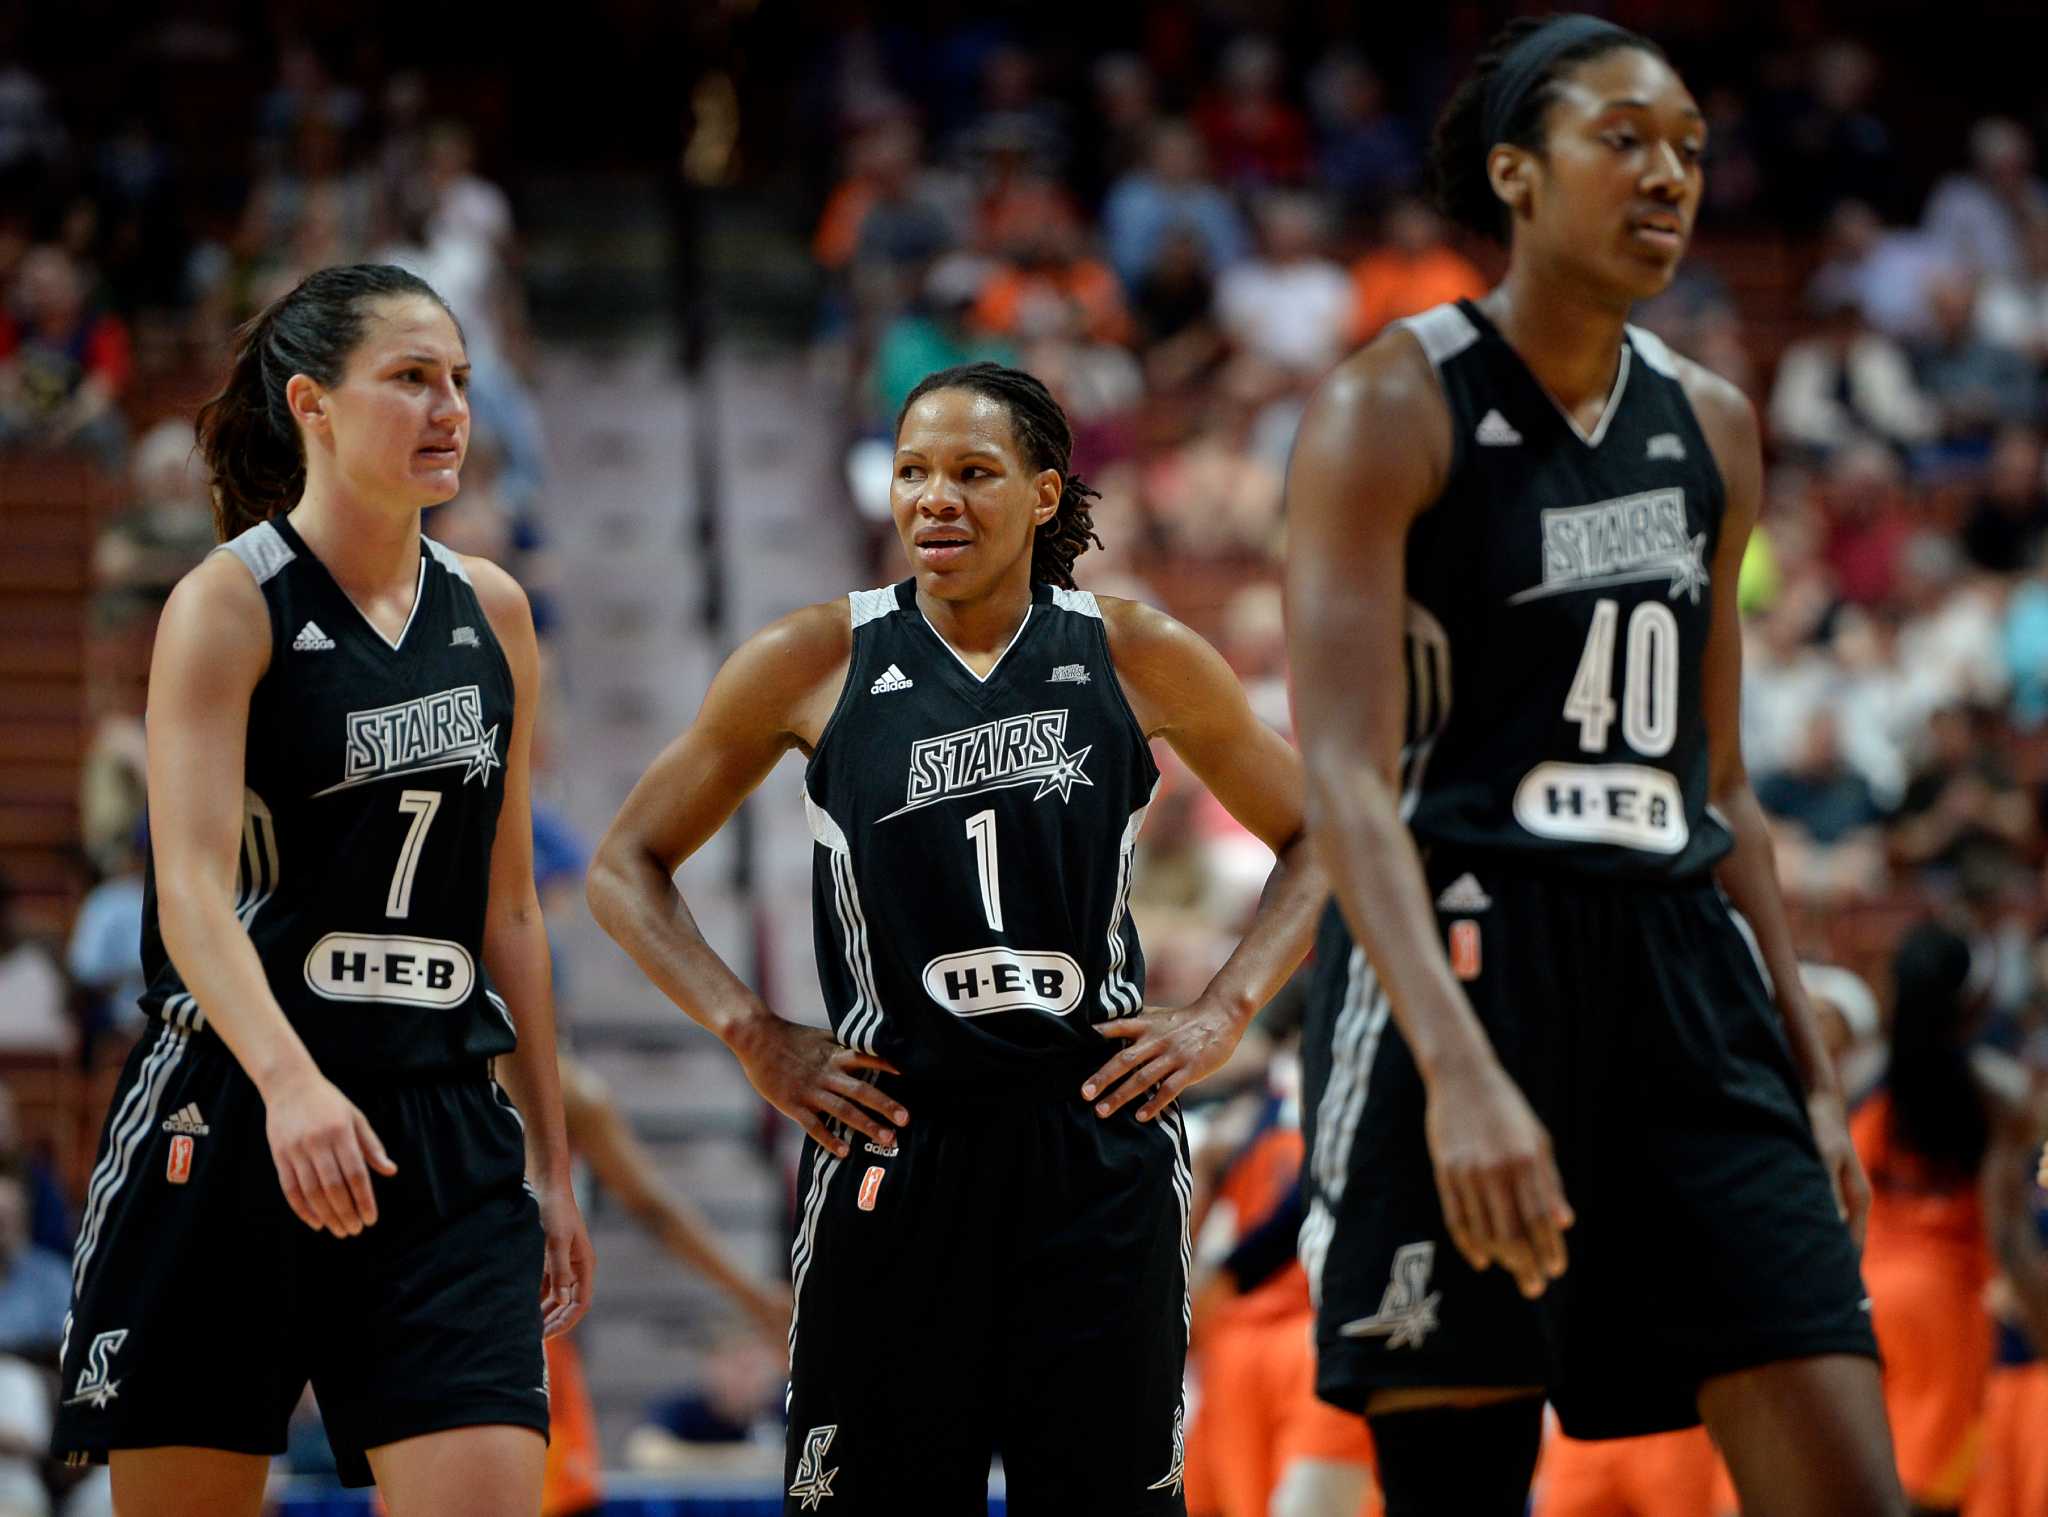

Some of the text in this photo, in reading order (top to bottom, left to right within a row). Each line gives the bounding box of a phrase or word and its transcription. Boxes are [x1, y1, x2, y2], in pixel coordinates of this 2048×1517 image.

[1542, 487, 1688, 583] STARS
[293, 638, 335, 650] adidas
[870, 678, 913, 695] adidas
[1563, 600, 1679, 757] 40
[345, 685, 482, 780] STARS
[907, 709, 1069, 804] STARS
[386, 790, 442, 918] 7
[965, 809, 1004, 932] 1
